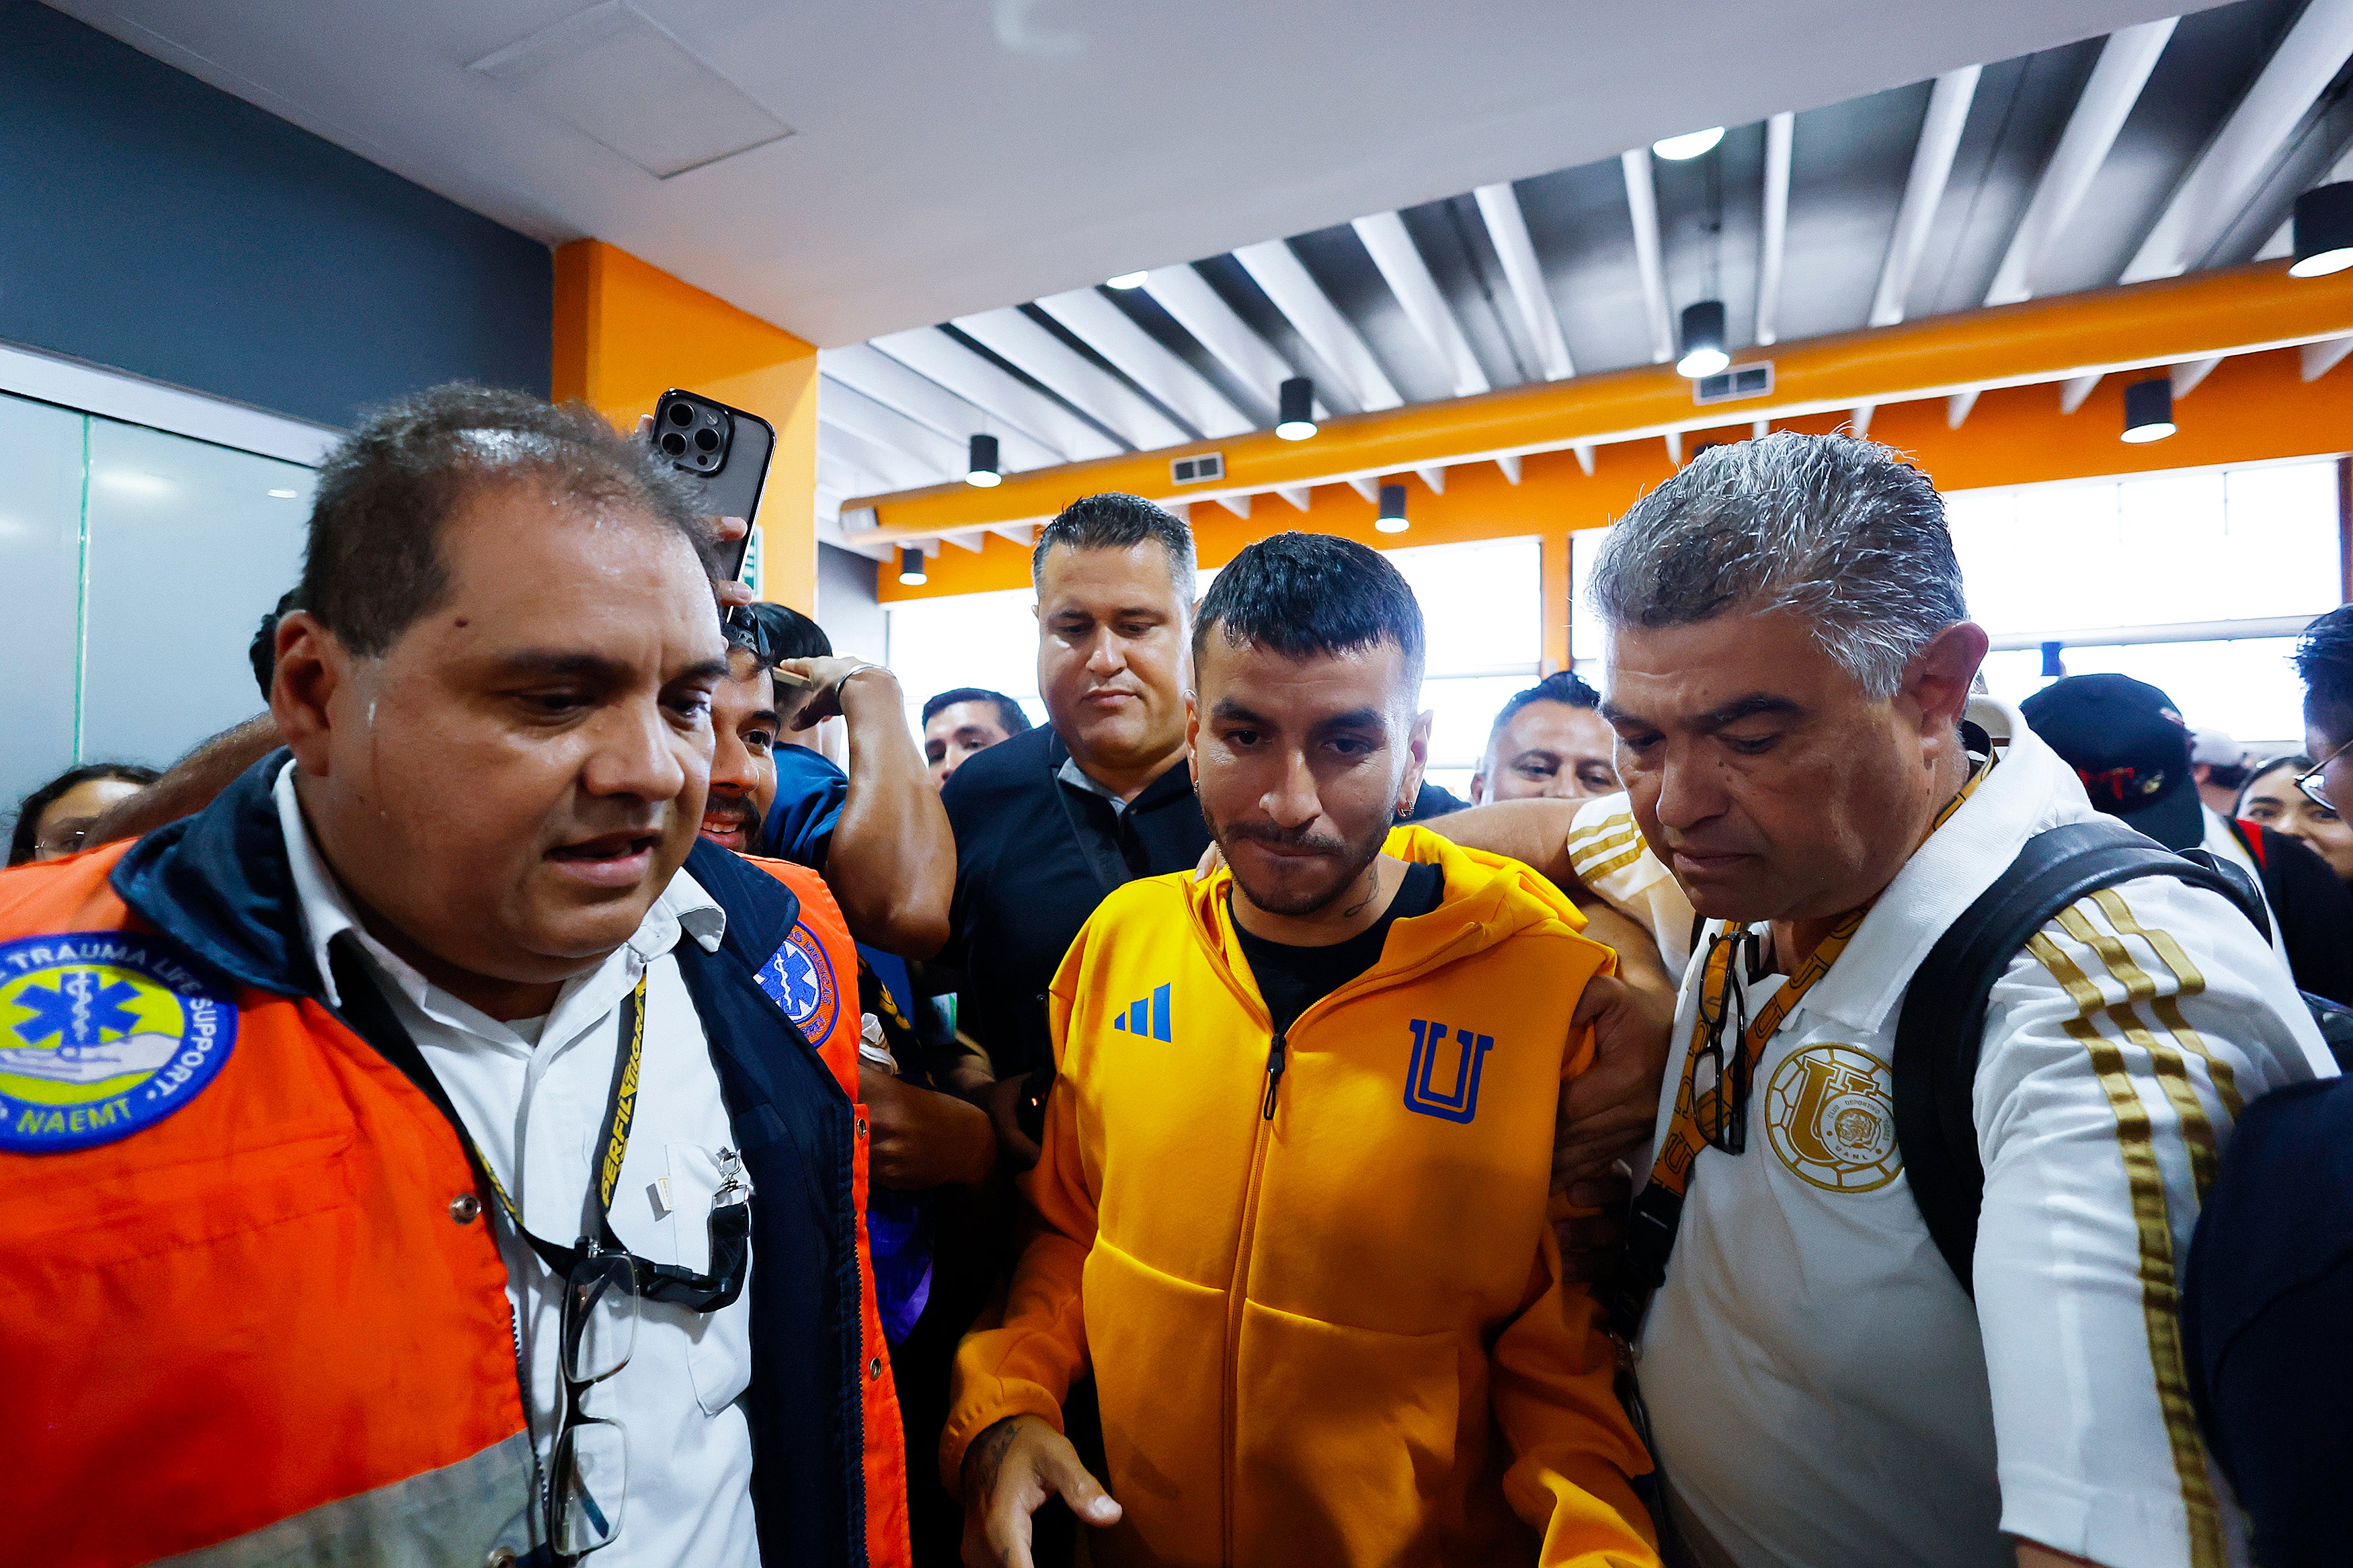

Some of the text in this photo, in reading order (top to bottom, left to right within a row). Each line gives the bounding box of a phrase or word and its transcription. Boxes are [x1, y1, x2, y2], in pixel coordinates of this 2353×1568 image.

[7, 942, 147, 968] TRAUMA
[154, 997, 217, 1097] SUPPORT
[803, 941, 832, 1005] MEDICAS
[15, 1098, 132, 1134] NAEMT
[1404, 1018, 1494, 1124] U
[601, 1097, 633, 1208] PERFIL
